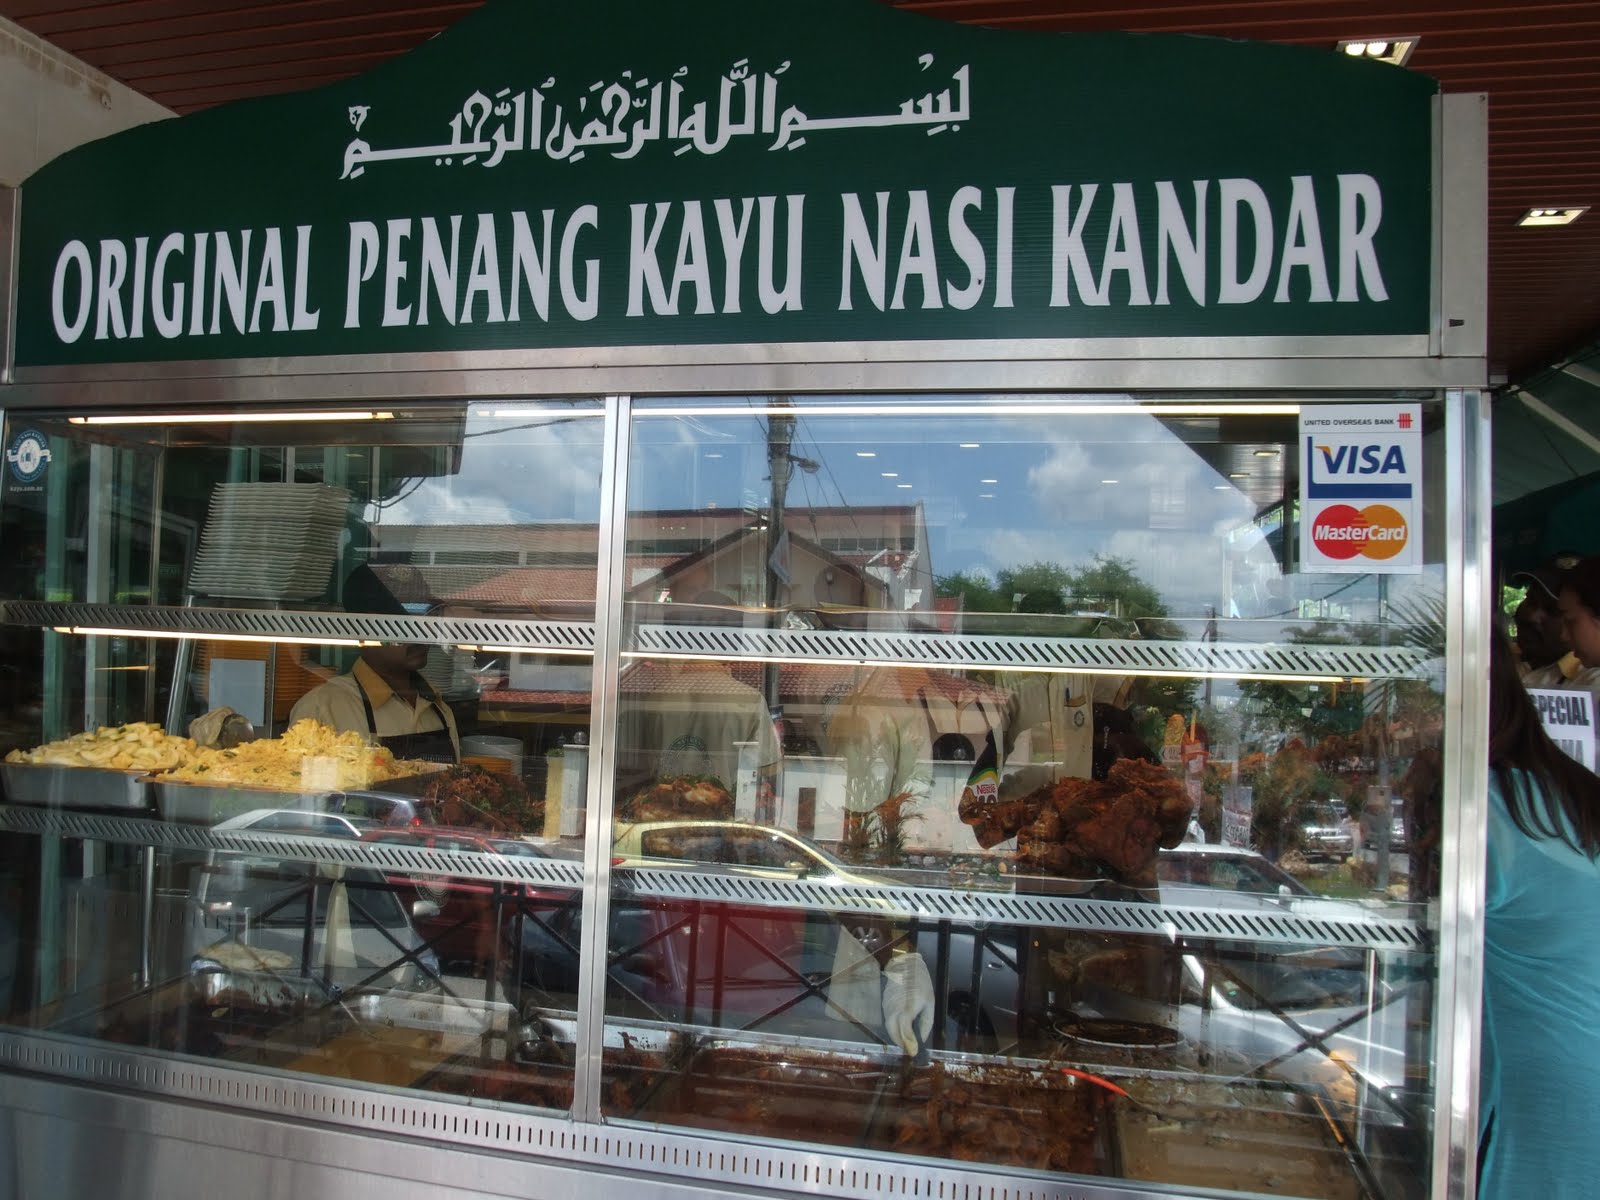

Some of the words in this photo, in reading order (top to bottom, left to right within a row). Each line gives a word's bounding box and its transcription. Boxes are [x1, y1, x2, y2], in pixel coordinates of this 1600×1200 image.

[52, 226, 320, 344] ORIGINAL
[344, 205, 599, 328] PENANG
[626, 194, 806, 317] KAYU
[839, 186, 1015, 312] NASI
[1049, 174, 1389, 307] KANDAR
[1333, 418, 1372, 426] OVERSEAS
[1314, 445, 1407, 475] VISA
[1314, 524, 1406, 541] MasterCard
